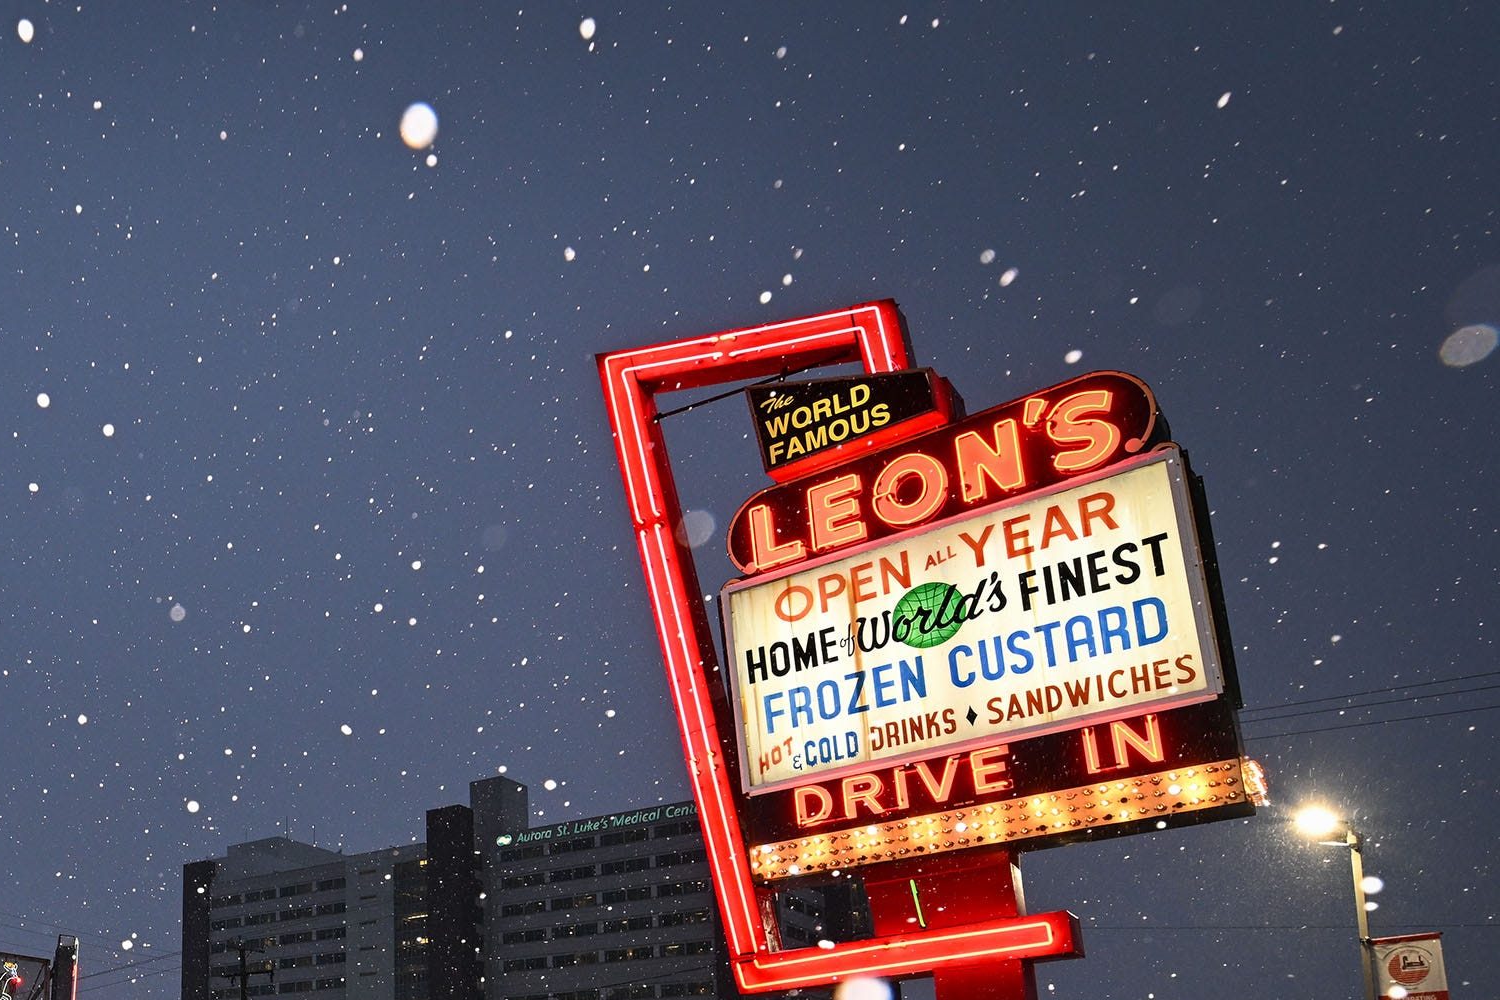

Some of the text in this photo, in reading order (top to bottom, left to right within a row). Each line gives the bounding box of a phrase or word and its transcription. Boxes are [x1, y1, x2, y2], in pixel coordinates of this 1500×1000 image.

[760, 394, 795, 414] The
[765, 383, 871, 439] WORLD
[768, 403, 891, 465] FAMOUS
[748, 389, 1120, 572] LEON'S
[746, 532, 1169, 684] HOME of World's FINEST
[774, 492, 1120, 622] OPEN ALL YEAR
[759, 736, 794, 775] HOT
[804, 731, 859, 767] COLD
[870, 708, 958, 751] DRINKS
[987, 654, 1197, 724] SANDWICHES
[763, 597, 1169, 734] FROZEN CUSTARD
[517, 829, 553, 843] Aurora
[556, 825, 570, 837] St.
[574, 819, 609, 834] Luke's
[612, 809, 661, 827] Medical
[794, 713, 1165, 829] DRIVE IN
